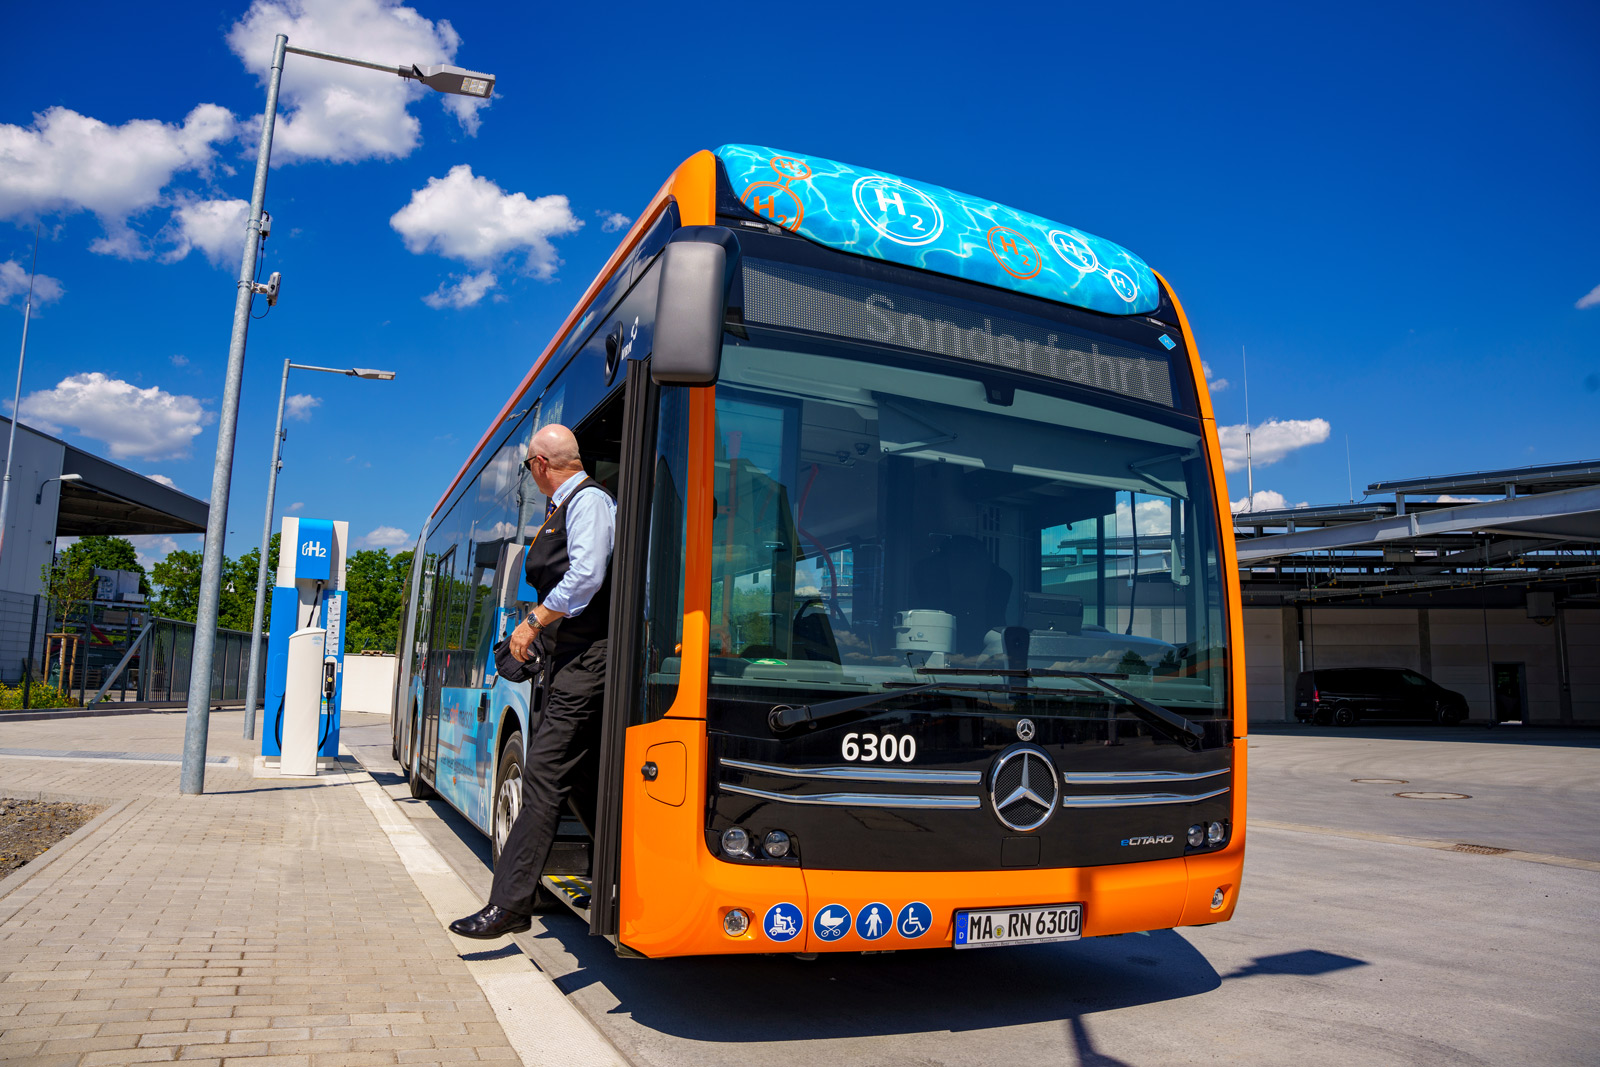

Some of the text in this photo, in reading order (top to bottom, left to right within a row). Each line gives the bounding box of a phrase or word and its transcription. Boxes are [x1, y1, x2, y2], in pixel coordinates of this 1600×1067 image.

[874, 188, 926, 232] H2
[1000, 235, 1031, 266] H2
[1114, 275, 1132, 297] H2
[865, 293, 1153, 398] Sonderfahrt
[308, 540, 326, 558] H2
[841, 732, 916, 763] 6300
[1120, 834, 1175, 847] eCITARO
[958, 931, 965, 940] D
[969, 909, 1079, 940] MA RN 6300
